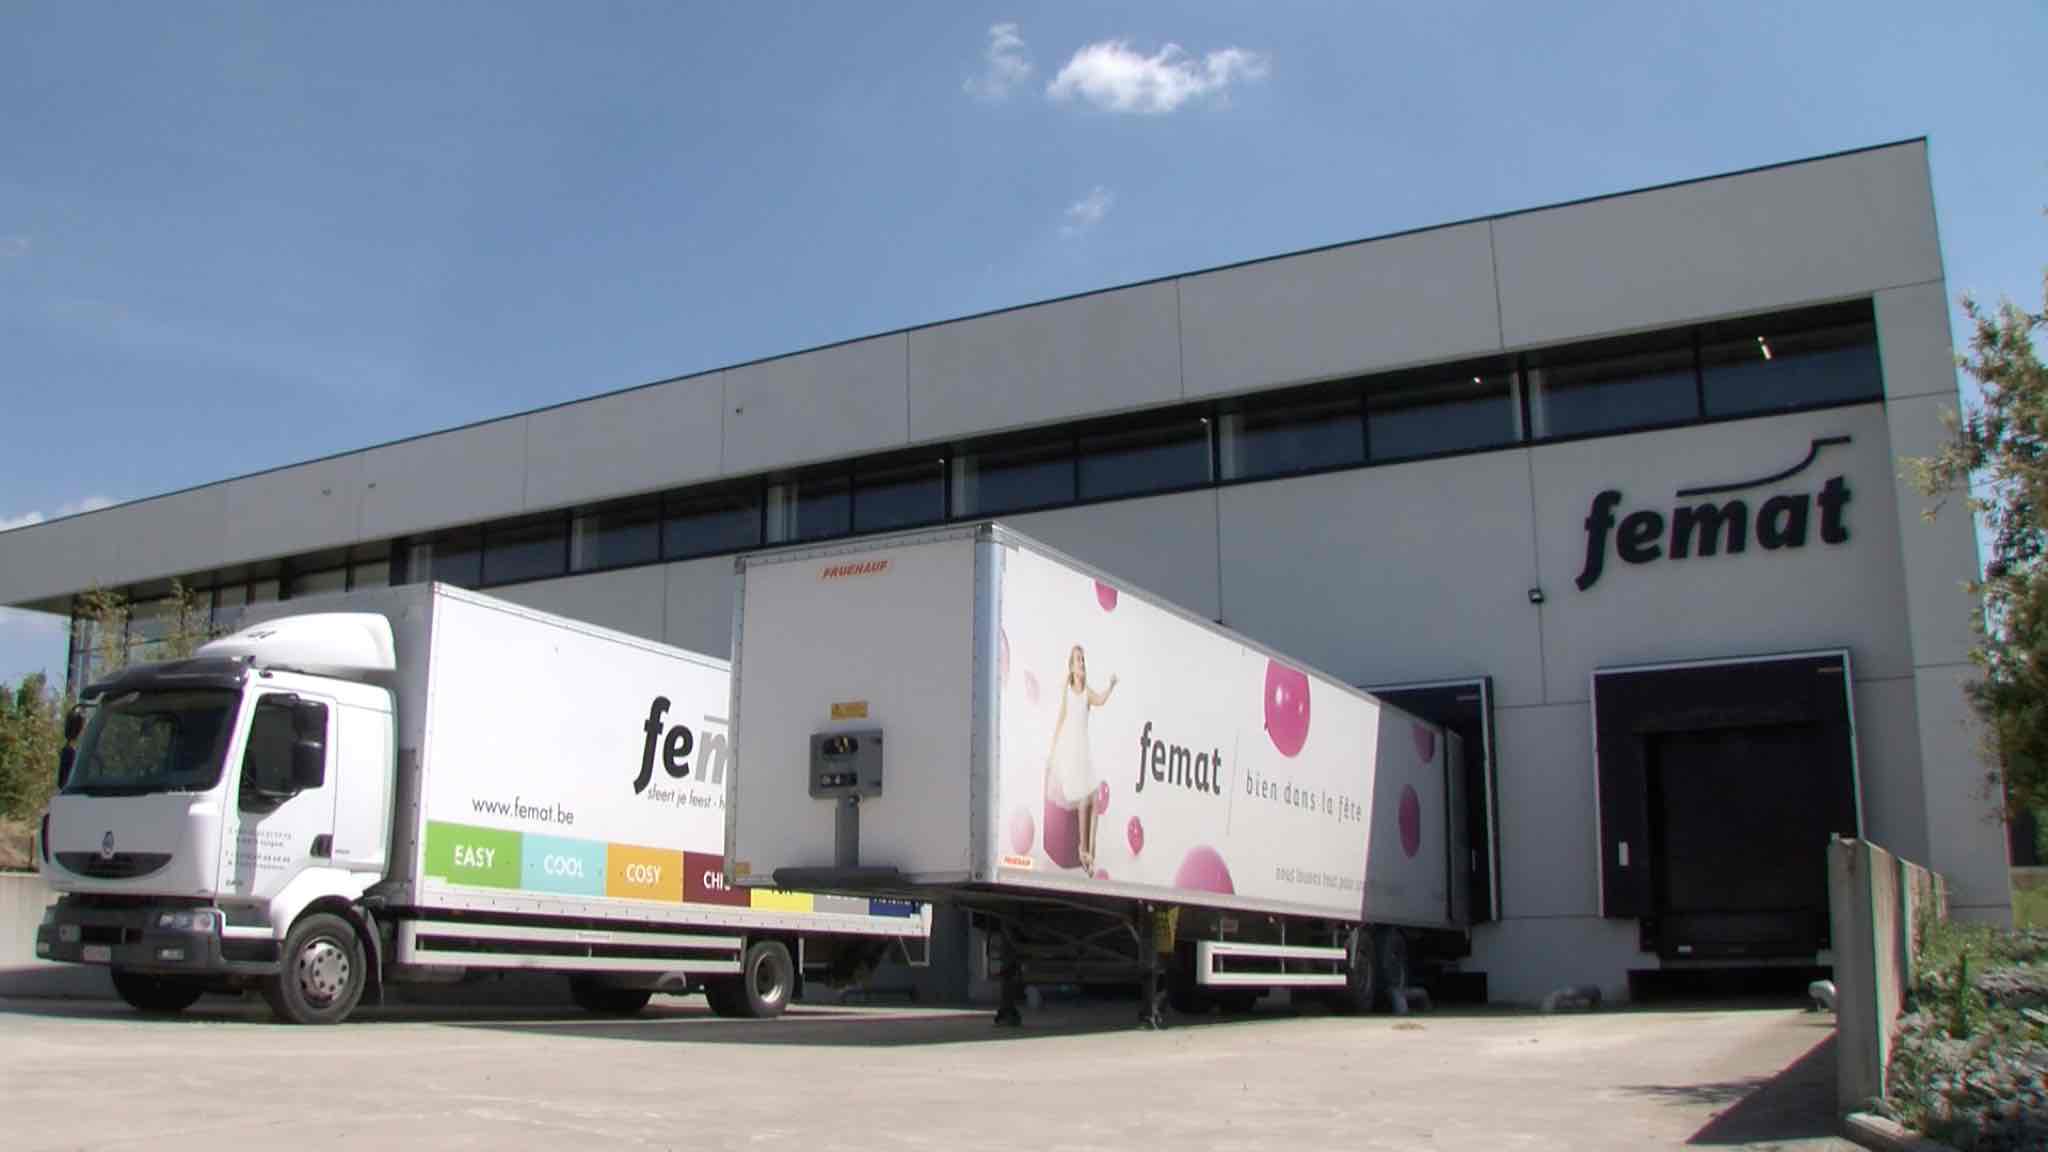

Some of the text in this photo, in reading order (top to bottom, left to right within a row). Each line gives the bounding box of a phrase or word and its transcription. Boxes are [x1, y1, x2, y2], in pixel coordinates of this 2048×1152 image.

[1575, 476, 1851, 591] femat
[1135, 721, 1222, 797] femat
[1246, 768, 1278, 800] bien
[1284, 781, 1316, 812] dans
[1322, 791, 1333, 815] la
[472, 795, 574, 824] www.femat.be
[454, 844, 496, 869] EASY
[543, 854, 585, 879] COOL
[624, 863, 662, 885] COSY
